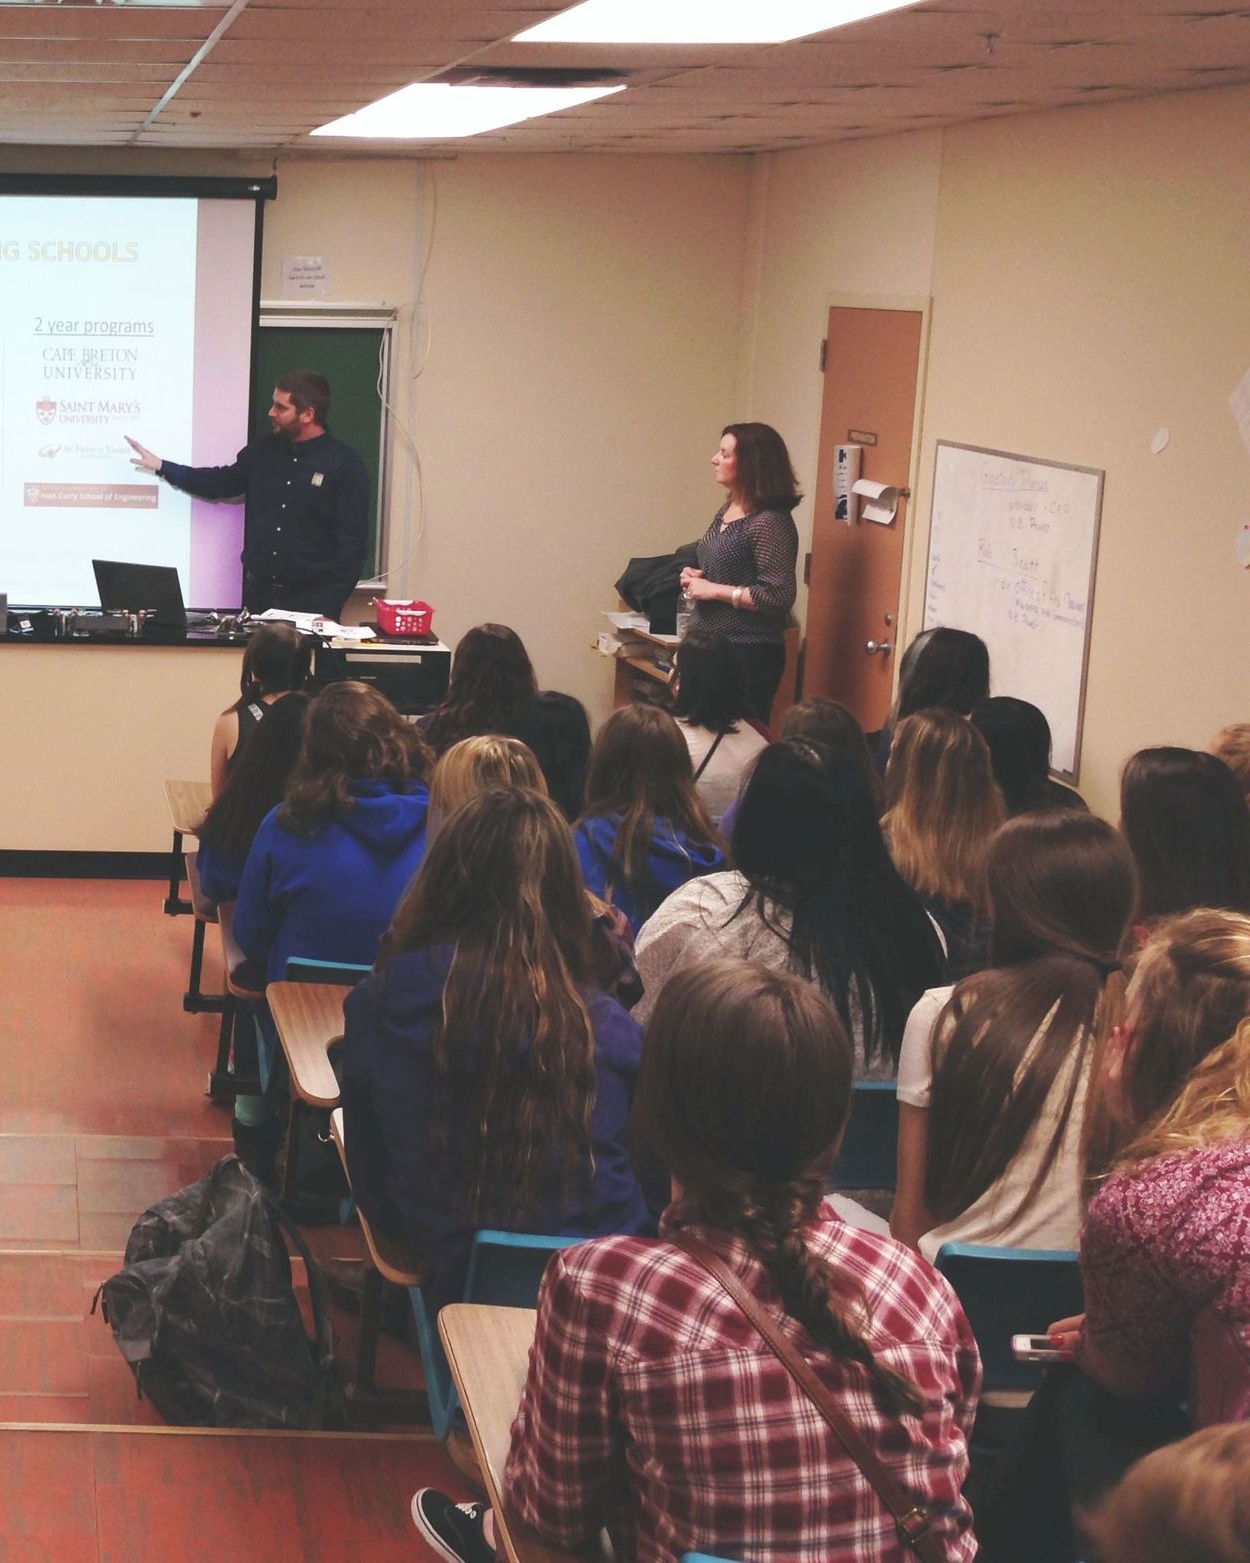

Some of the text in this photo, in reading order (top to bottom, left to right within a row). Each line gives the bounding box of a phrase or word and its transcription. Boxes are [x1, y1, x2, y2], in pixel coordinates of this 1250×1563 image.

[27, 240, 139, 263] SCHOOLS
[33, 317, 154, 337] 2 year programs
[41, 348, 139, 363] CAPE BRETON
[43, 366, 138, 381] UNIVERSITY
[59, 399, 142, 414] SAINT MARY'S
[59, 414, 110, 425] UNIVERSITY
